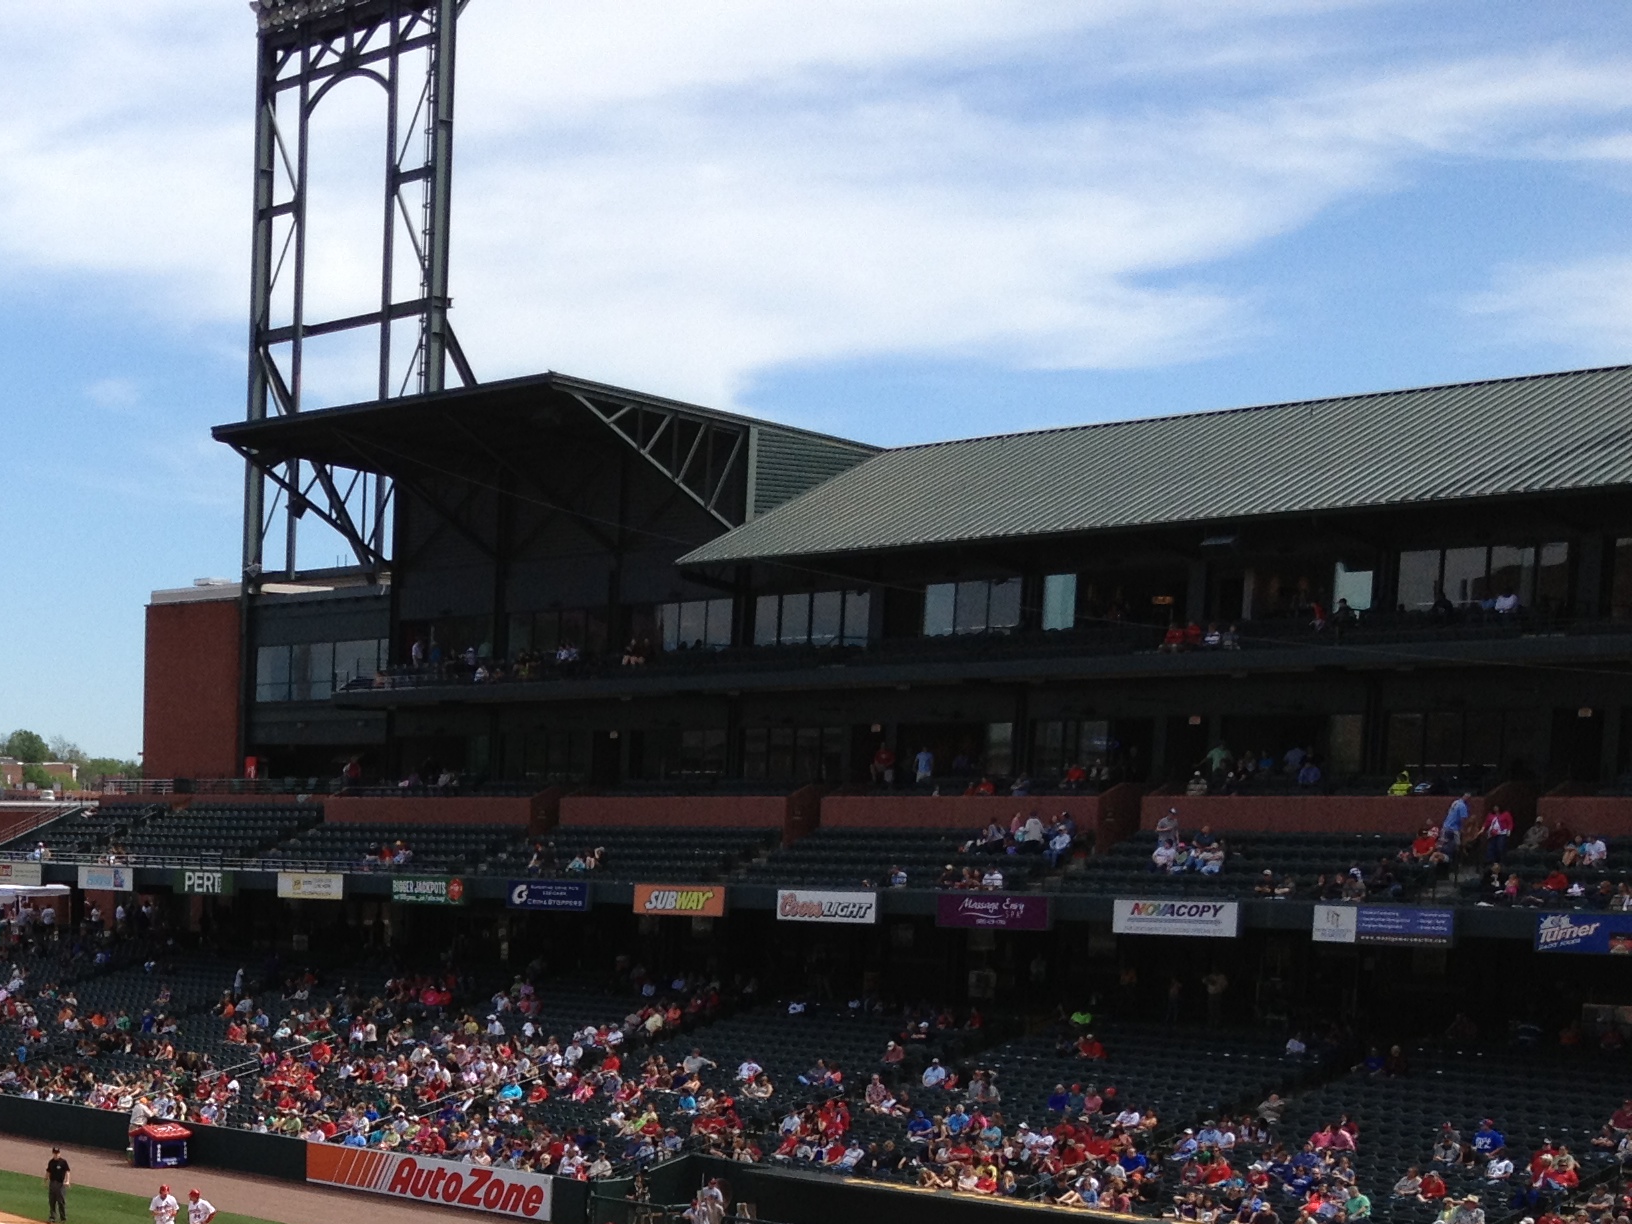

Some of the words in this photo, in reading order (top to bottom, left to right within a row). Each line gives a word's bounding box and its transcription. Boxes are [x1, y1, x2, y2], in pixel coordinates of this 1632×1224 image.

[184, 872, 218, 893] PERT
[645, 889, 714, 910] SUBWAY
[780, 893, 823, 917] Coors
[822, 902, 873, 918] LIGHT
[958, 898, 999, 913] Massage
[1002, 898, 1024, 914] Envy
[1130, 903, 1225, 917] NOVACOPY
[1539, 922, 1601, 943] Turner
[387, 1157, 544, 1217] AutoZone
